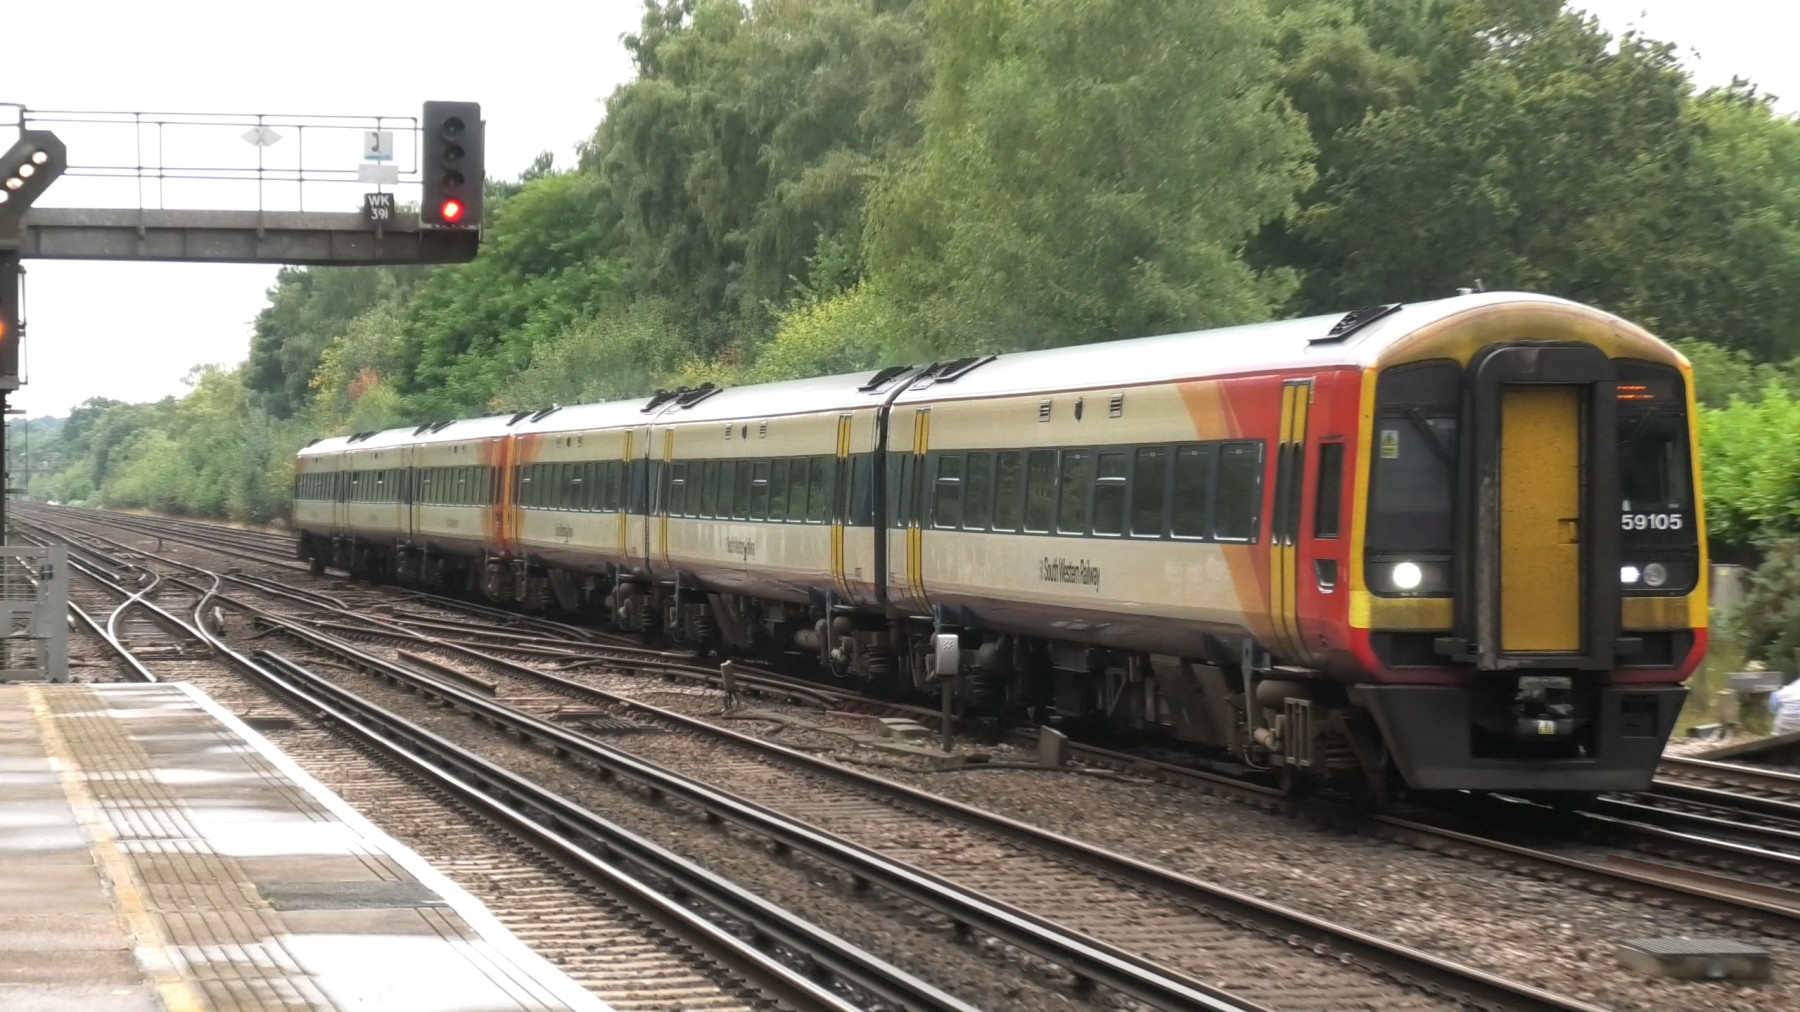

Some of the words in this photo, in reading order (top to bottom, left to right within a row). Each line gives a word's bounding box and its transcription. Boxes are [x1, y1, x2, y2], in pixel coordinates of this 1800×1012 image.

[368, 195, 390, 206] WK
[370, 208, 389, 220] 391
[1621, 513, 1683, 531] 59105
[1043, 556, 1058, 582] South
[1058, 558, 1080, 584] Western
[1080, 559, 1101, 593] Railway
